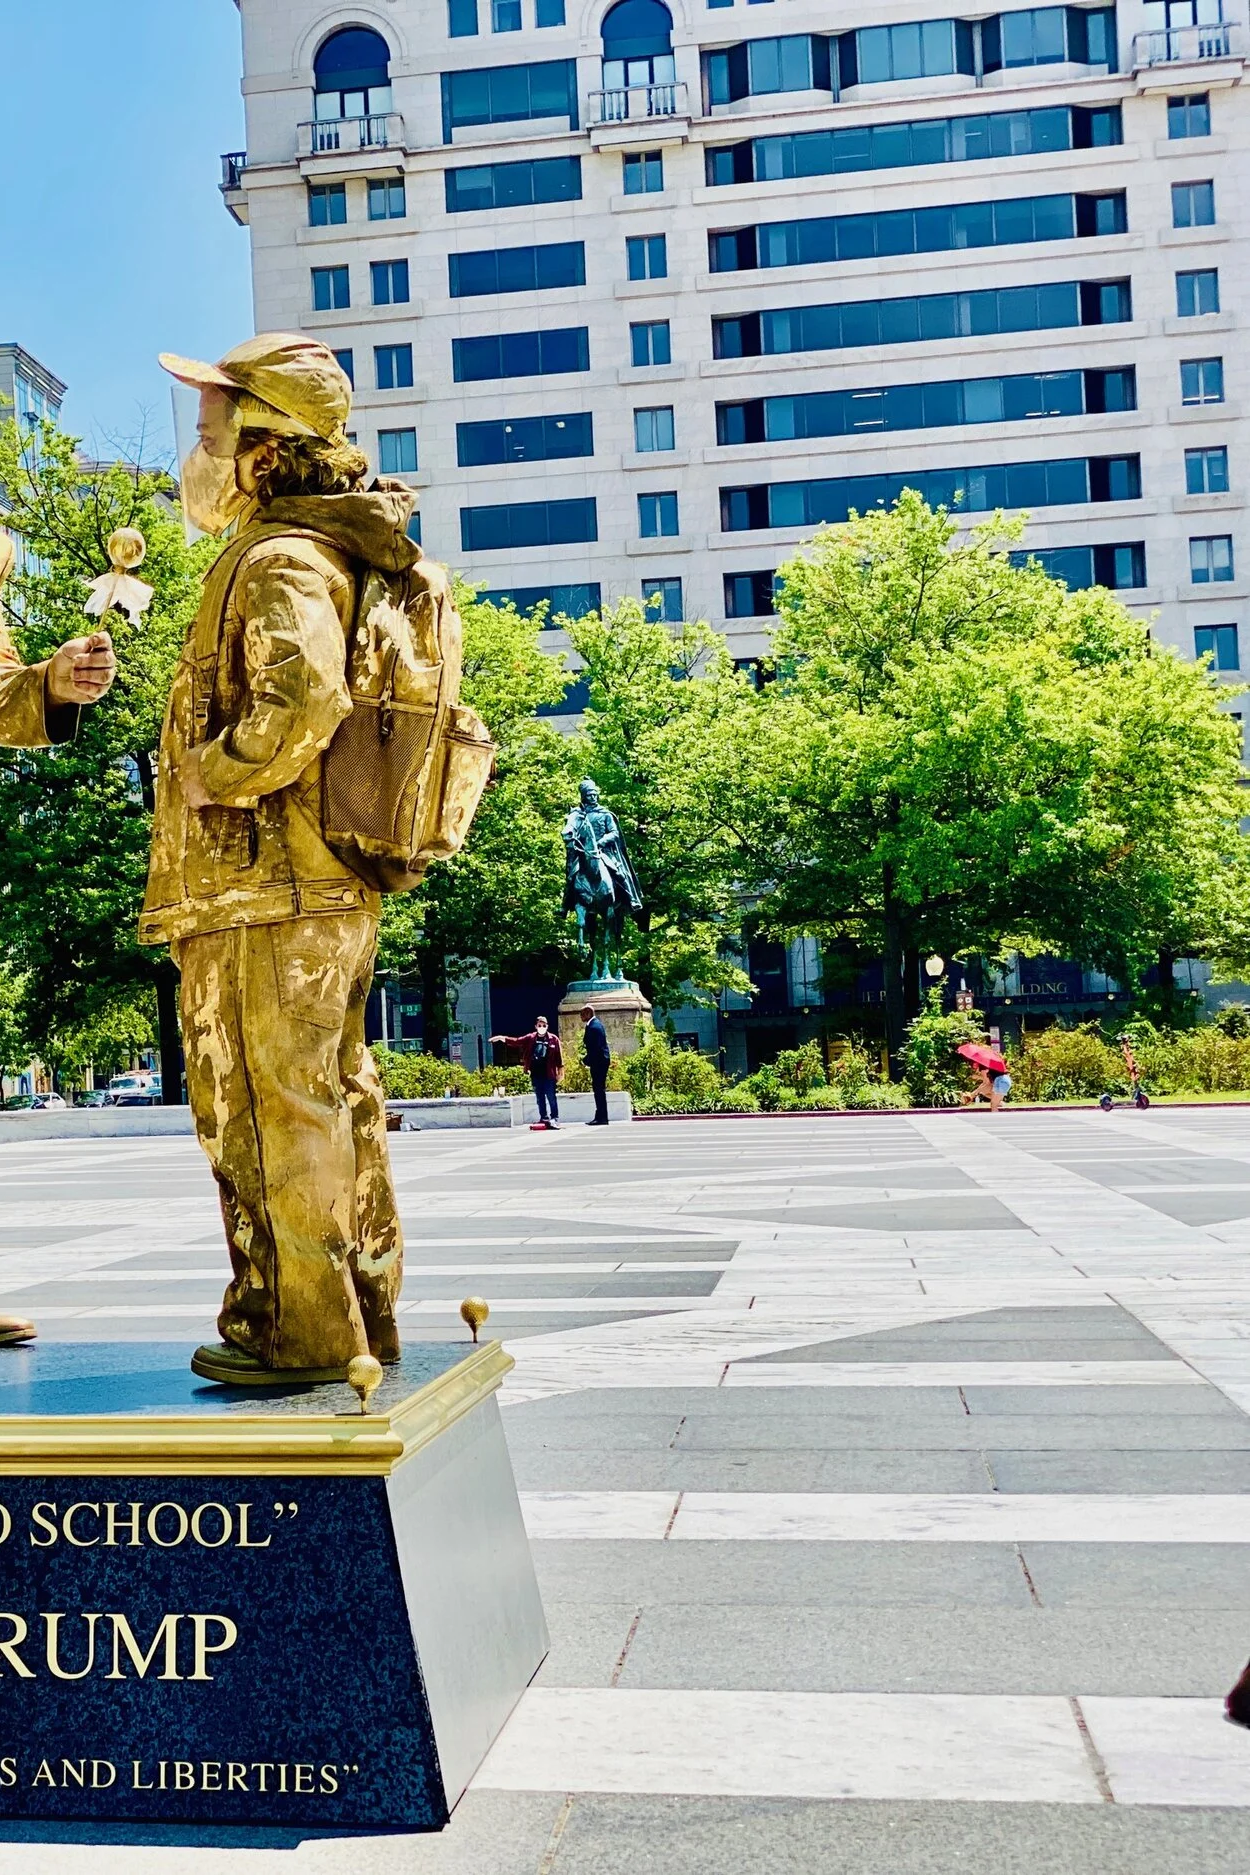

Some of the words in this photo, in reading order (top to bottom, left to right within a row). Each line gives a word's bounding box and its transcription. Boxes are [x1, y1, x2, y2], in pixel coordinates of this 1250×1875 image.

[29, 1502, 298, 1547] SCHOOL”
[31, 1758, 116, 1788] AND
[132, 1760, 359, 1794] LIBERTIES”
